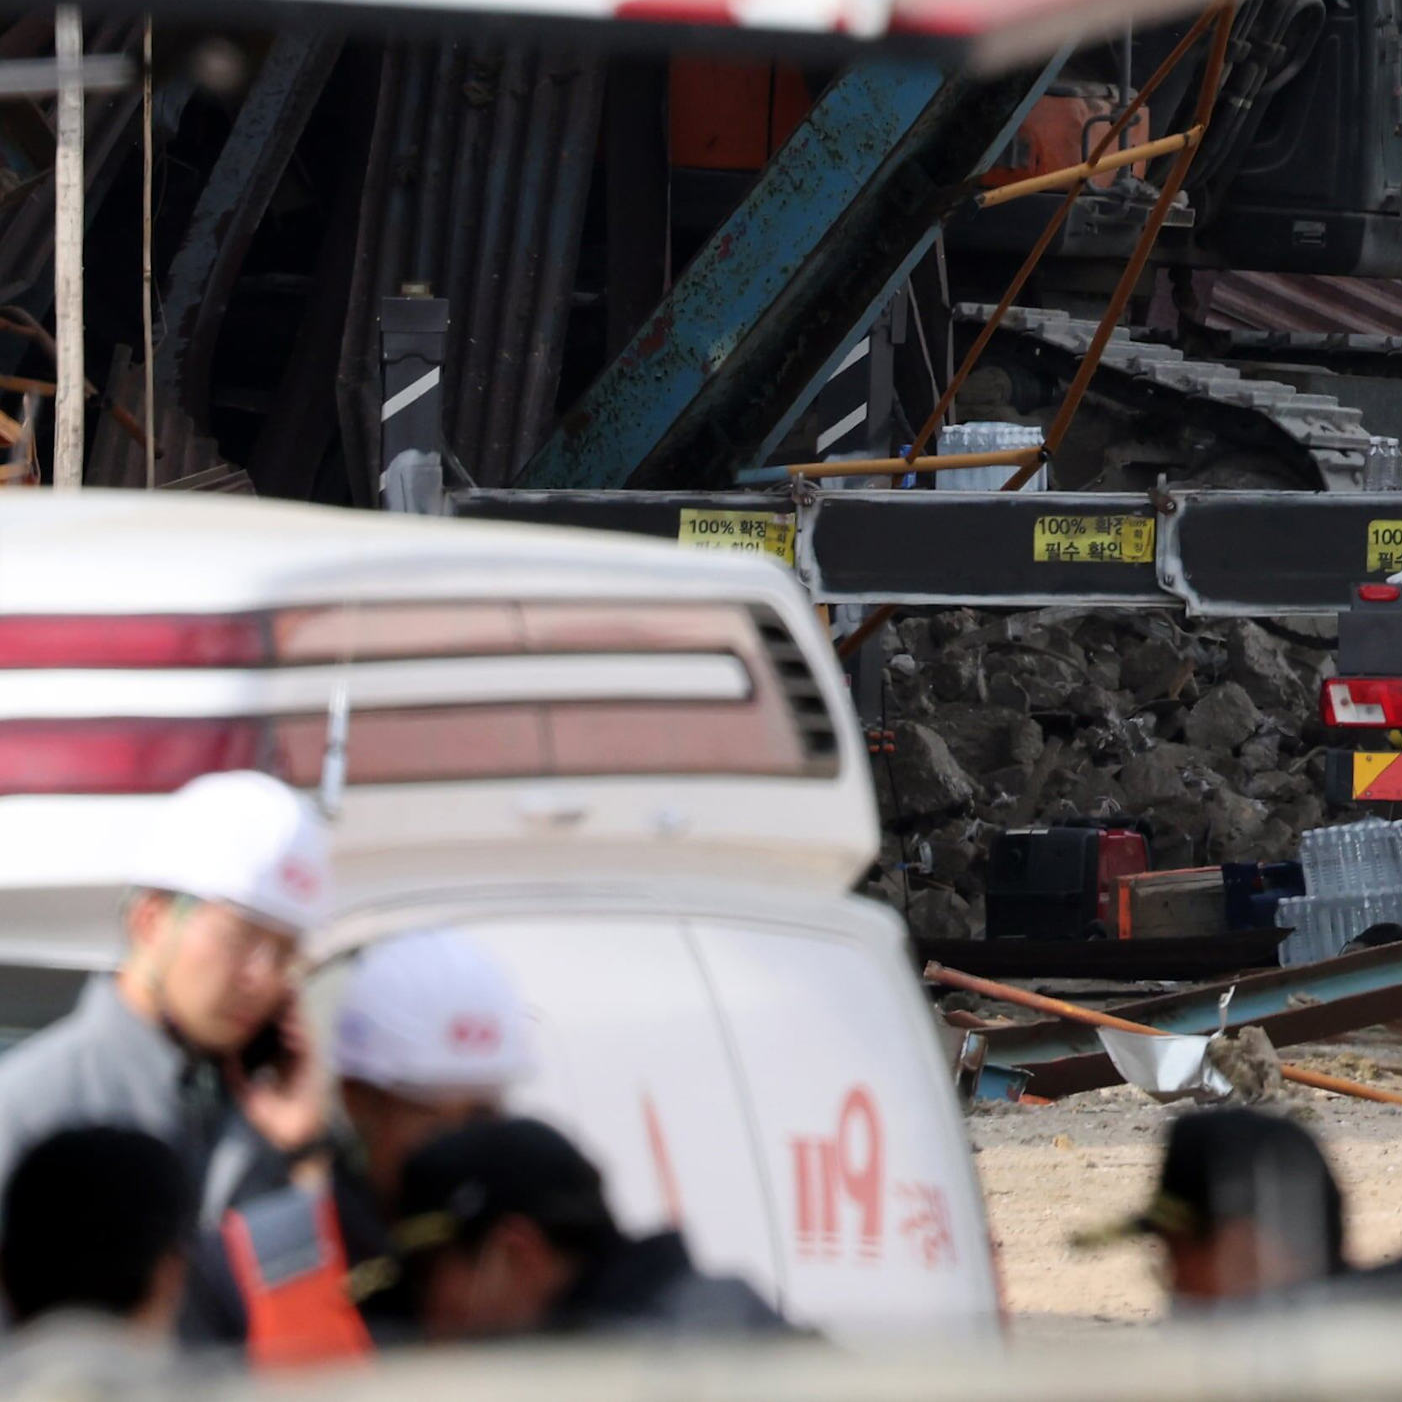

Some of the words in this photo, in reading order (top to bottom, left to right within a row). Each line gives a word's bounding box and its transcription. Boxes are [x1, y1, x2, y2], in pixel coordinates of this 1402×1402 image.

[689, 519, 735, 535] 100%
[1038, 517, 1087, 535] 100%
[1045, 541, 1080, 561] 필수
[1087, 541, 1123, 561] 확인
[791, 1083, 885, 1259] 119
